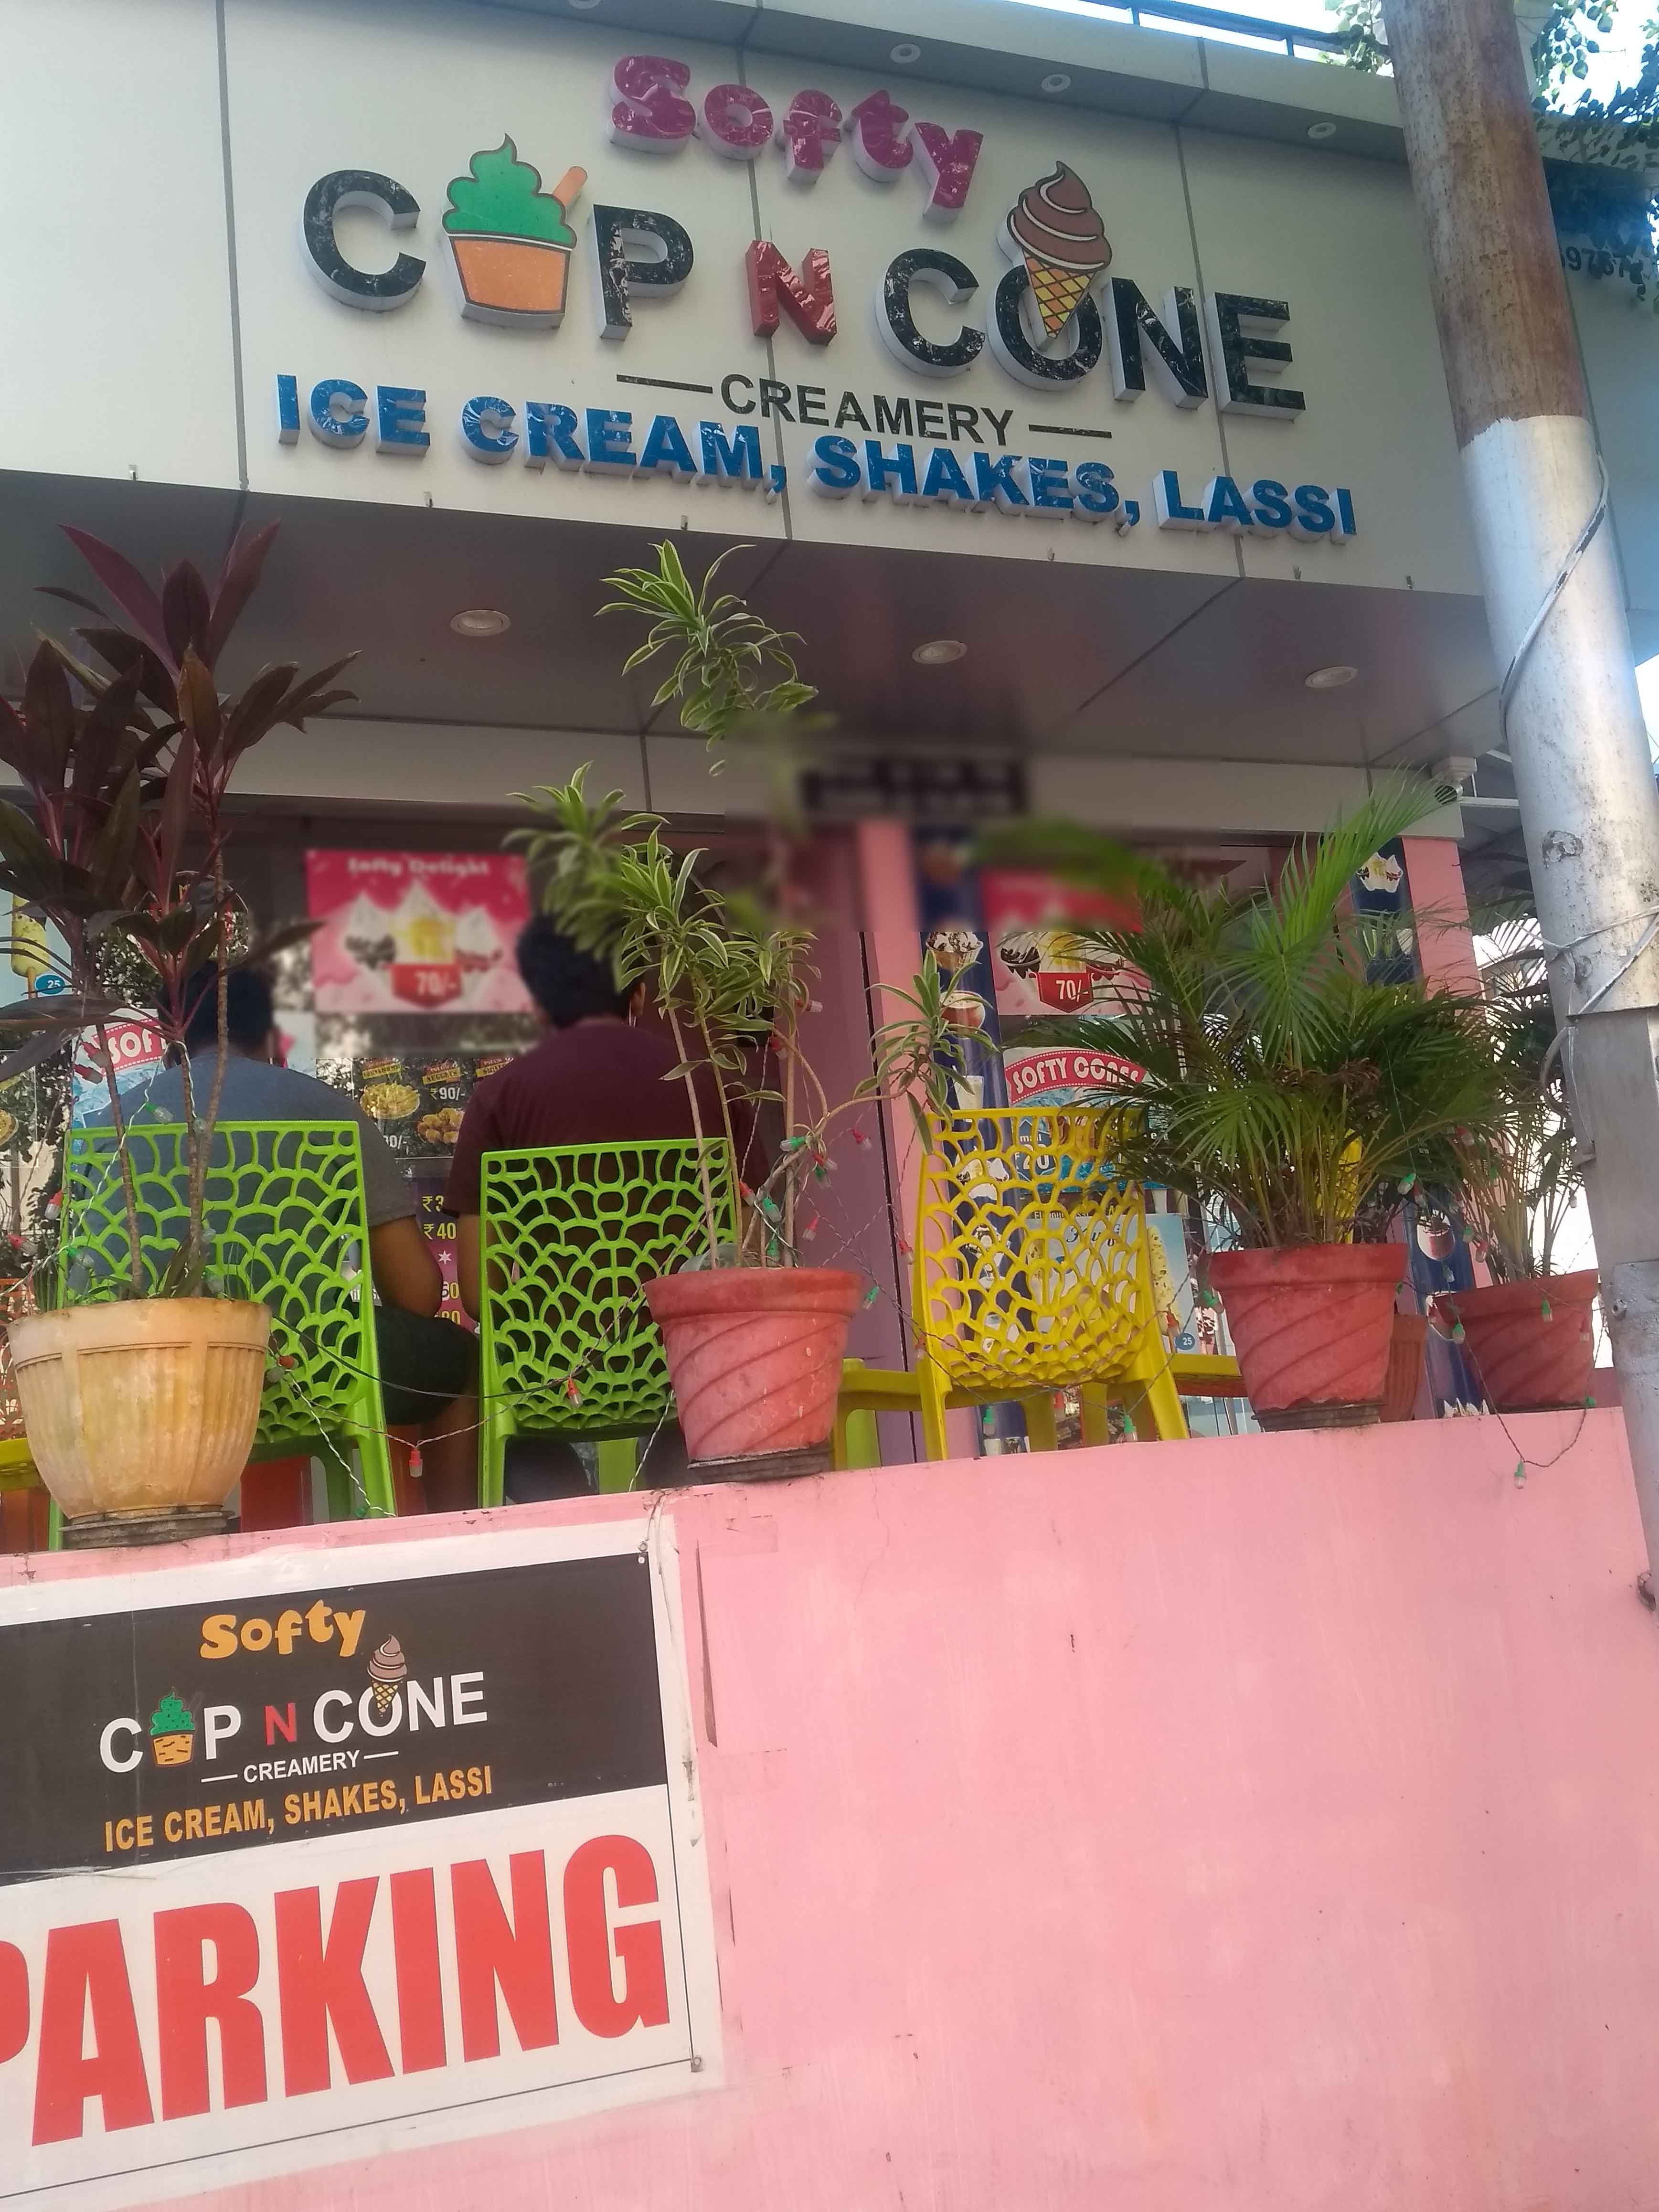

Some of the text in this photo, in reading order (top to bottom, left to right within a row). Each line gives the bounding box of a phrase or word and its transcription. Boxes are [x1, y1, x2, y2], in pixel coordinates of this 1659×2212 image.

[610, 54, 984, 211] Softy
[745, 240, 837, 345] N
[881, 248, 1306, 412] CONE
[721, 374, 1013, 445] CREAMERY
[276, 374, 1357, 536] ICE CREAM, SHAKES, LASSI
[1056, 979, 1088, 1002] 70/-
[108, 1028, 166, 1064] SOF
[1013, 1057, 1067, 1094] SOFTY
[199, 1599, 366, 1659] Softy
[264, 1702, 297, 1746] N
[313, 1671, 488, 1744] CONE
[243, 1750, 360, 1784] CREAMERY
[104, 1765, 493, 1853] ICE CREAM, SHAKES, LASSI
